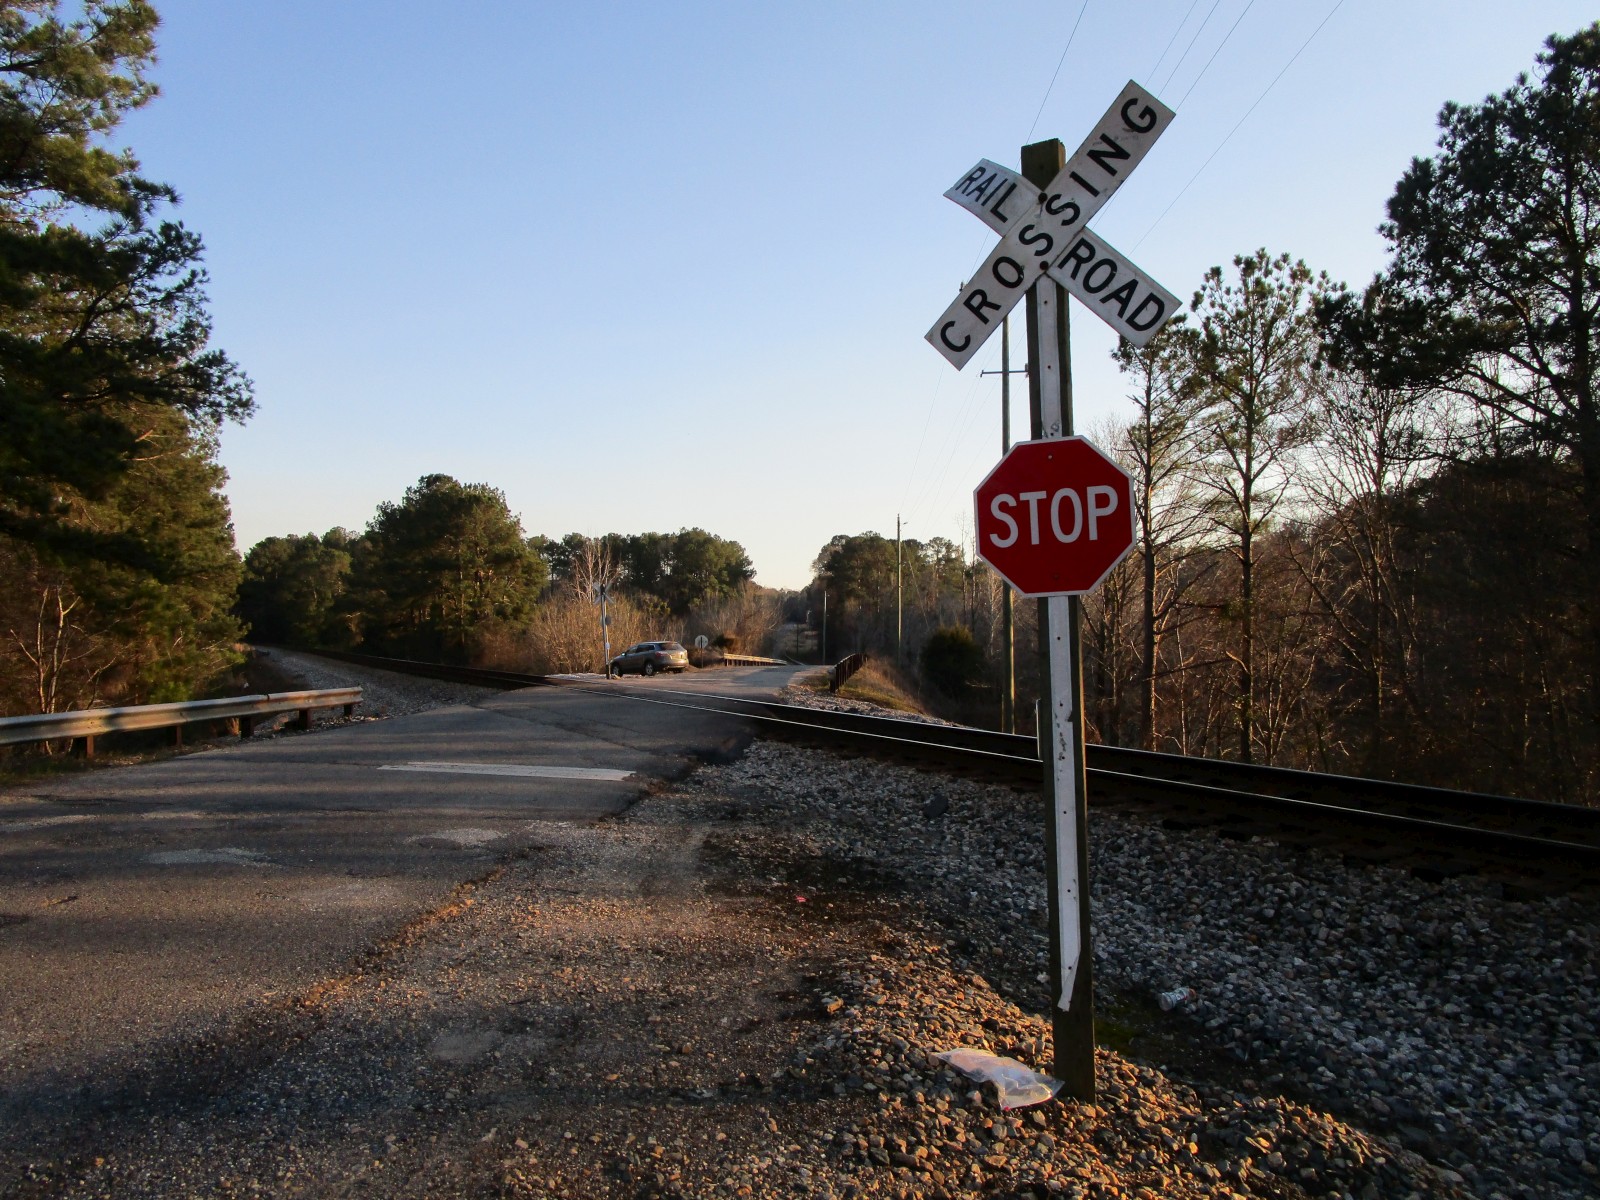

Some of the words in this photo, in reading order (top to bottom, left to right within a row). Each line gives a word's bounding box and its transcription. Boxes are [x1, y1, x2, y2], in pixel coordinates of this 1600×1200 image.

[940, 97, 1158, 353] CROSSING
[955, 166, 1017, 223] RAIL
[1057, 237, 1165, 331] ROAD
[989, 484, 1119, 548] STOP
